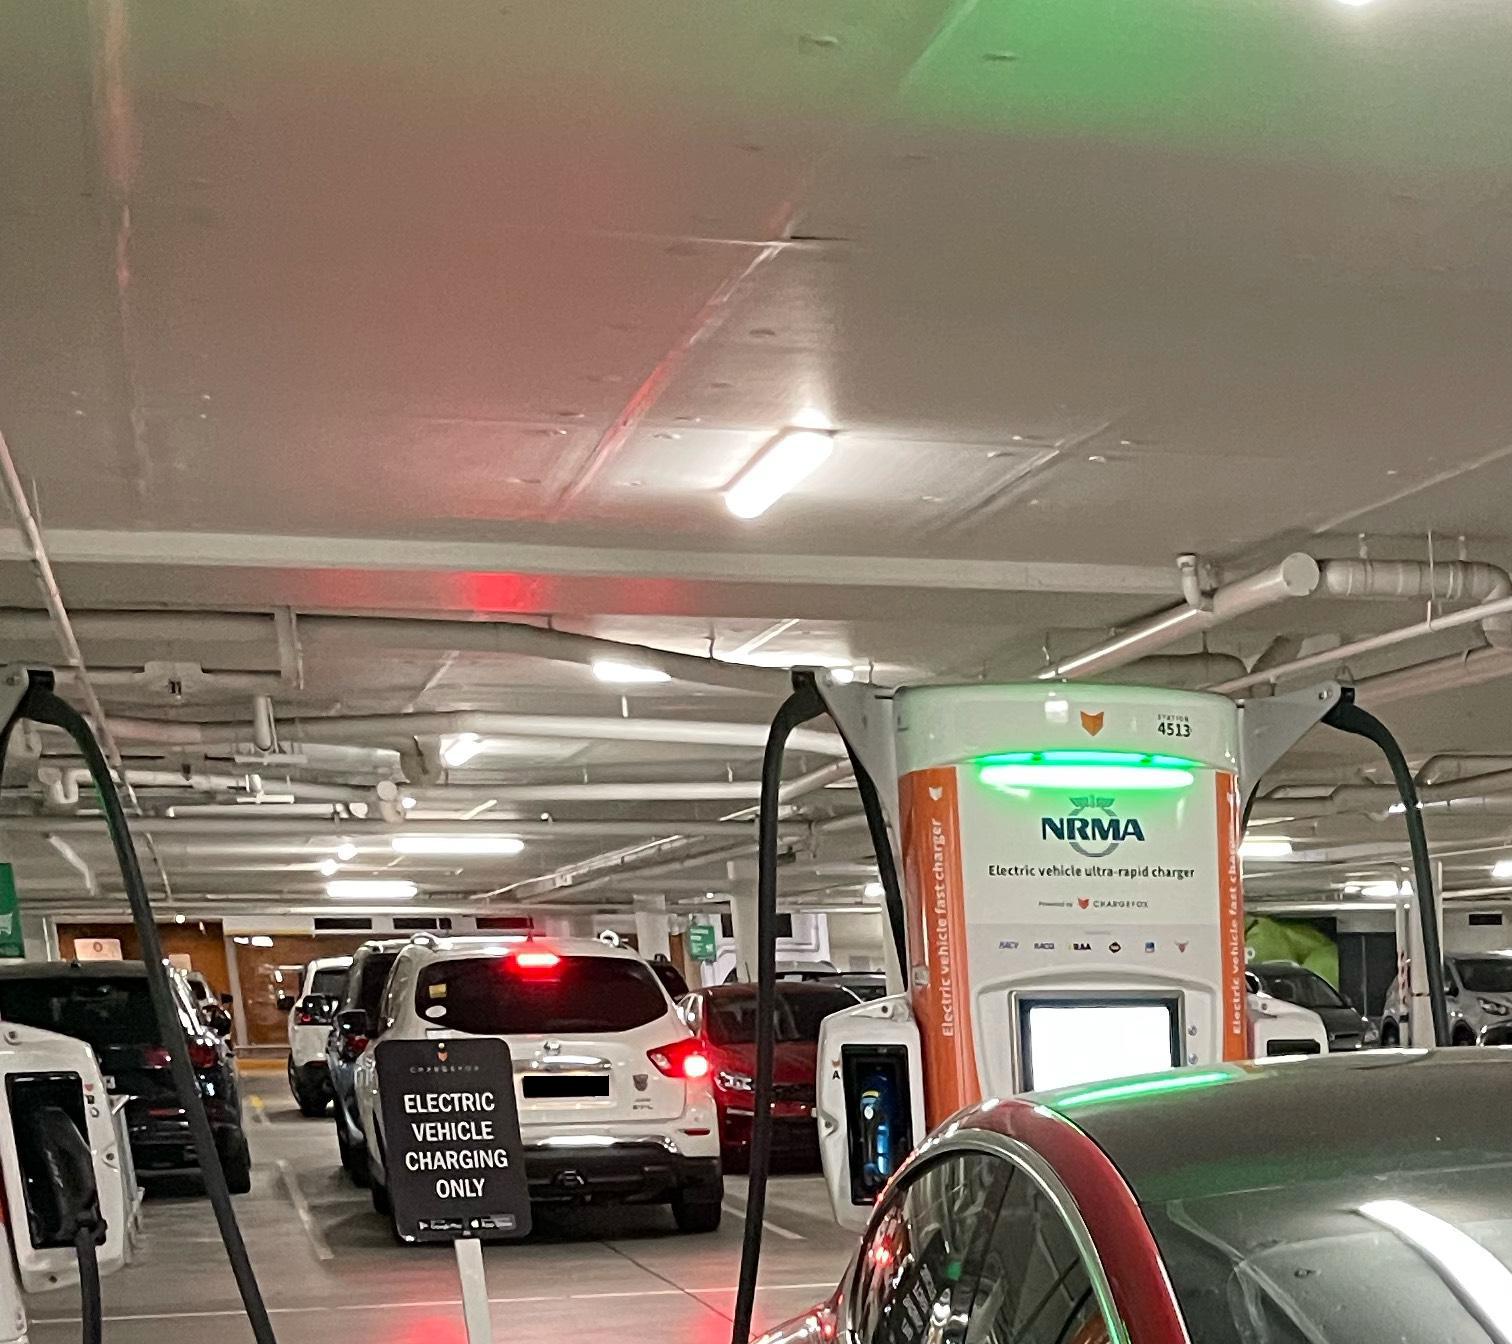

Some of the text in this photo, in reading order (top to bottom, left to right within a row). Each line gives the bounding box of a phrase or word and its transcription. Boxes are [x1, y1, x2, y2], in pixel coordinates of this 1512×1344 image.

[1157, 722, 1191, 737] 4513
[1041, 817, 1145, 841] NRMA
[988, 865, 1195, 880] Electric vehicle ultra-rapid charger
[1228, 886, 1238, 915] fast
[932, 818, 954, 1036] Electric vehicle fast charger
[1230, 919, 1239, 974] vehicle
[1231, 977, 1241, 1034] Electric
[832, 1070, 841, 1080] A
[404, 1092, 495, 1113] ELECTRIC
[411, 1121, 495, 1142] VEHICLE
[405, 1149, 509, 1171] CHARGING
[436, 1178, 485, 1199] ONLY
